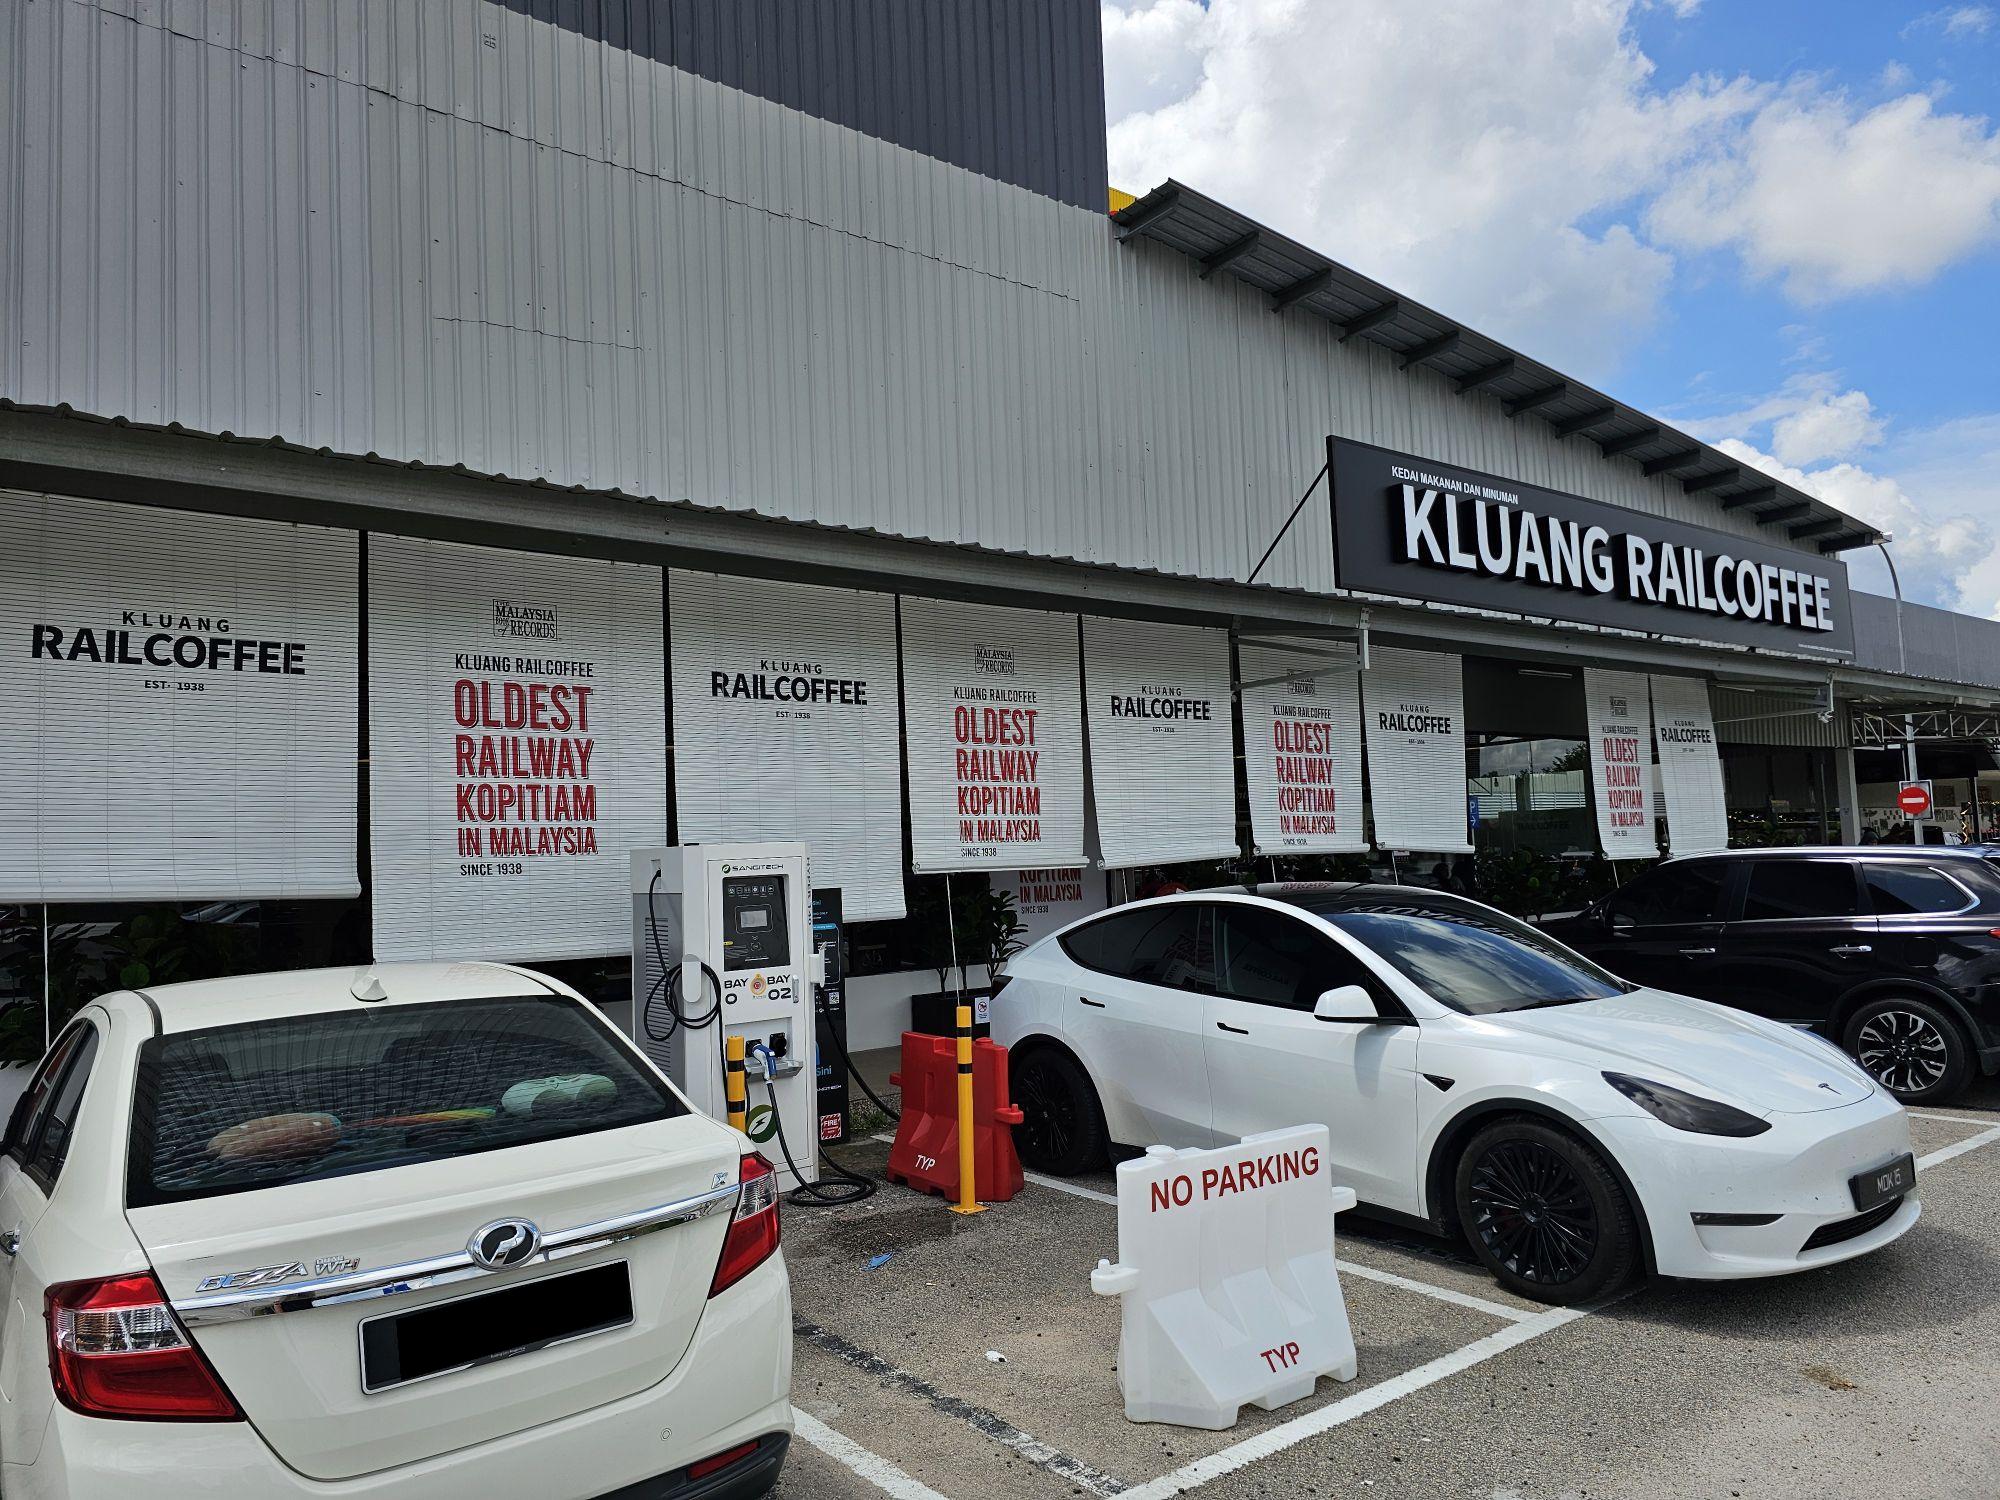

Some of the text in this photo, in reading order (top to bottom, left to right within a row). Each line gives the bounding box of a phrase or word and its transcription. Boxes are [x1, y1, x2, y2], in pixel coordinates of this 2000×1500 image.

[1391, 465, 1519, 504] KEDAI MAKANAN DAN MINUMAN
[1402, 484, 1834, 631] KLUANG RAILCOFFEE
[122, 611, 231, 633] KLUANG
[495, 605, 555, 621] MALAYSIA
[510, 620, 556, 638] RECORDS
[31, 624, 306, 675] RAILCOFFEE
[455, 653, 594, 677] KLUANG RAILCOFFEE
[760, 659, 822, 674] KLUANG
[177, 682, 205, 691] 1938
[711, 671, 867, 705] RAILCOFFEE
[954, 686, 1037, 703] KLUANG RAILCOFFEE
[1141, 685, 1182, 696] KLUANG
[454, 679, 593, 732] OLDEST
[1110, 695, 1211, 720] RAILCOFFEE
[1273, 704, 1331, 720] KLUANG RAILCOFFEE
[1400, 704, 1430, 713] KLUANG
[954, 706, 1038, 746] OLDEST
[1379, 712, 1451, 734] RAILCOFFEE
[1274, 720, 1332, 754] OLDEST
[1661, 727, 1711, 743] RAILCOFFEE
[456, 734, 595, 779] RAILWAY
[1603, 738, 1638, 763] OLDEST
[956, 748, 1039, 783] RAILWAY
[1276, 755, 1333, 785] RAILWAY
[1605, 765, 1640, 787] RAILWAY
[457, 783, 597, 822] KOPITIAM
[957, 786, 1041, 816] KOPITIAM
[1278, 786, 1335, 813] KOPITIAM
[1608, 790, 1643, 809] KOPITIAM
[960, 820, 1041, 843] IN MALAYSIA
[1280, 815, 1336, 834] IN MALAYSIA
[457, 826, 599, 857] IN MALAYSIA
[961, 847, 997, 857] SINCE 1938
[460, 863, 523, 876] SINCE 1938
[1020, 884, 1082, 903] IN MALAYSIA
[724, 978, 749, 989] BAY
[767, 974, 791, 985] BAY
[823, 1119, 838, 1127] FIRE
[914, 1153, 936, 1171] TYP
[1151, 1146, 1319, 1212] NO PARKING
[195, 1261, 308, 1292] BEZZA
[1260, 1341, 1300, 1373] TYP
